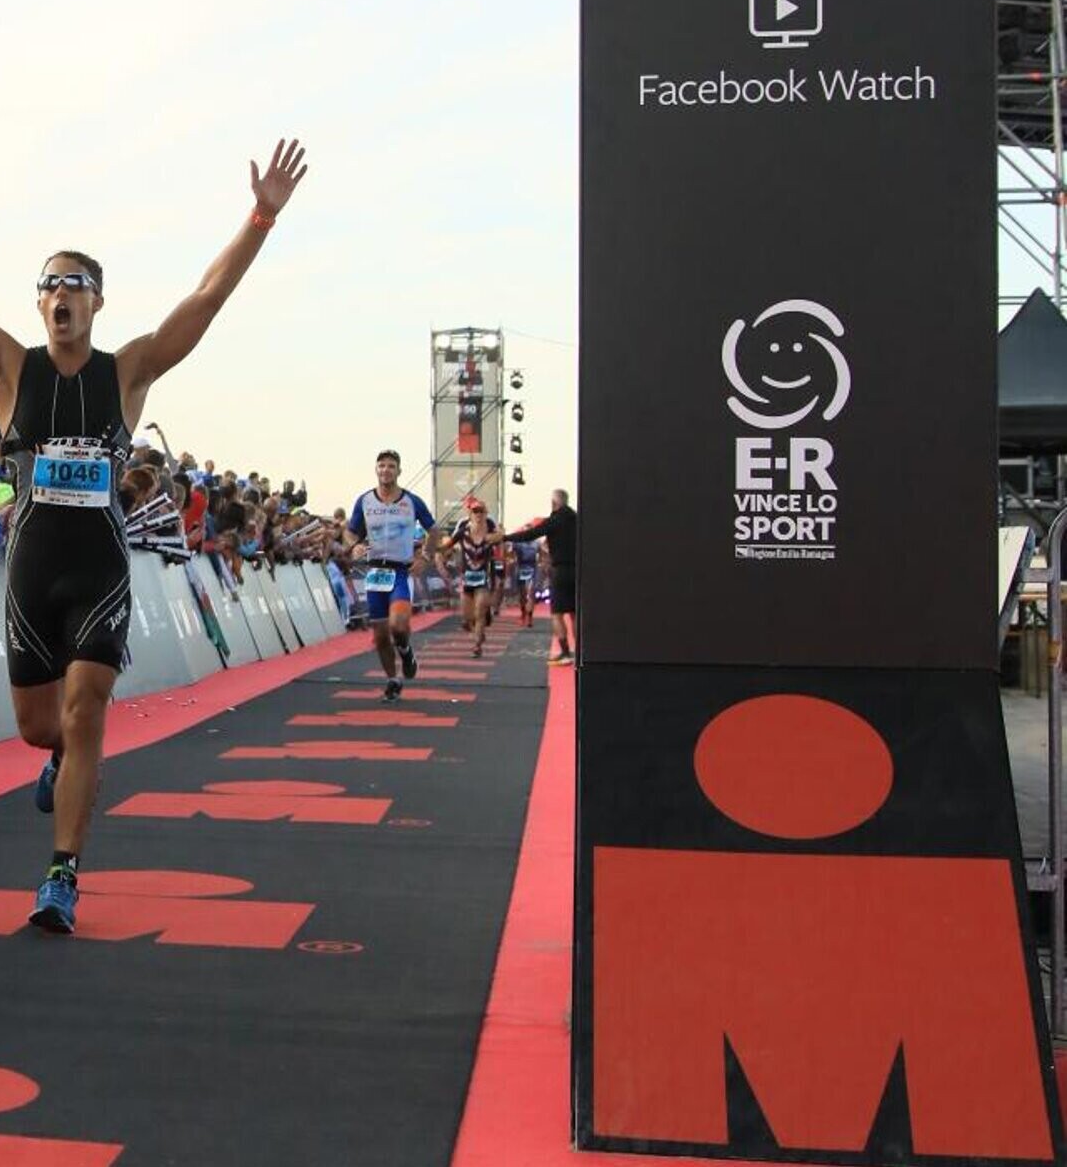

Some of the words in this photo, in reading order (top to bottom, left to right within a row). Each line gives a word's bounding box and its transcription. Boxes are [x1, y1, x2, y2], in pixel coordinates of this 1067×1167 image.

[639, 69, 808, 106] Facebook
[818, 66, 935, 101] Watch
[46, 462, 102, 483] 1046
[735, 437, 838, 490] E-R
[734, 494, 801, 512] VINCE
[806, 494, 838, 512] LO
[734, 515, 836, 541] SPORT
